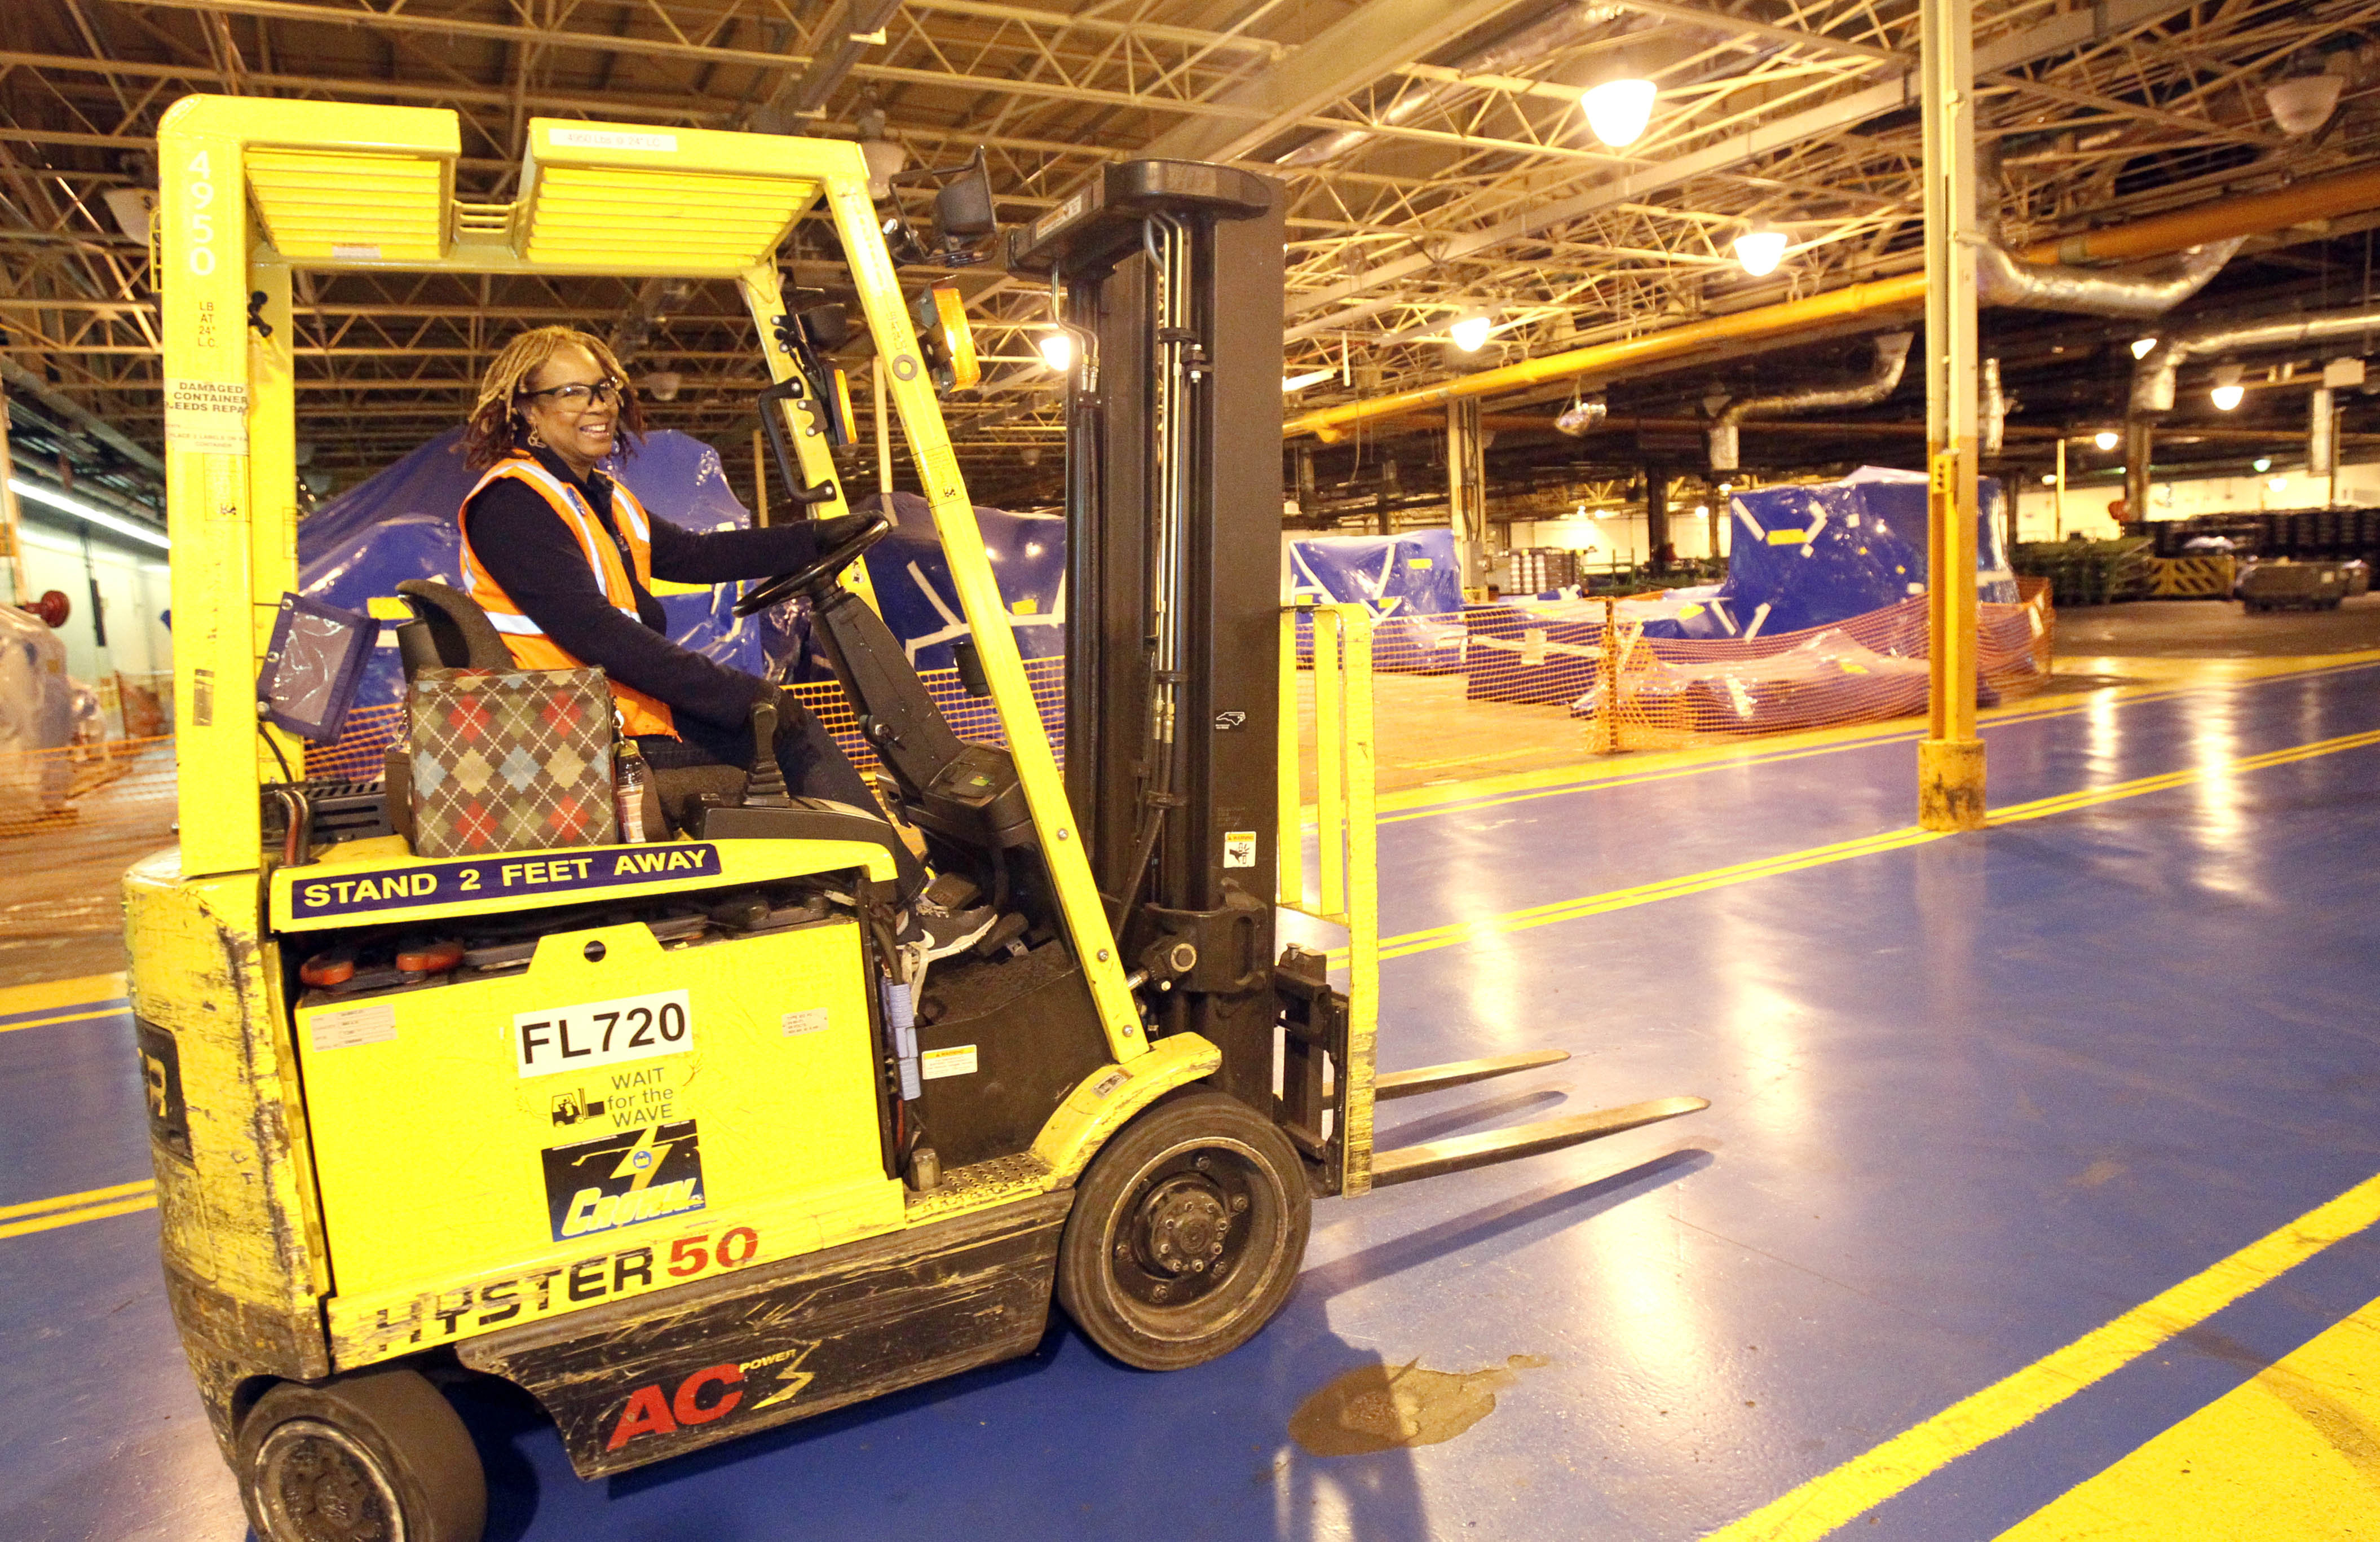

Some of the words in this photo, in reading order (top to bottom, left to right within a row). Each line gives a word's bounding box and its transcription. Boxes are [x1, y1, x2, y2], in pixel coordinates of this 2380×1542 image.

[188, 150, 217, 276] 4950
[199, 302, 214, 311] LB
[200, 314, 214, 323] AT
[174, 391, 248, 404] CONTAINER
[179, 382, 244, 394] DAMAGED
[304, 872, 437, 907] STAND
[460, 869, 481, 891] 2
[502, 857, 593, 887] FEET
[613, 849, 707, 876] AWAY
[521, 1002, 686, 1065] FL720
[611, 1067, 664, 1090] WAIT
[607, 1095, 635, 1111] for
[642, 1088, 673, 1103] the
[612, 1103, 673, 1127] WAVE
[668, 1226, 758, 1277] 50
[606, 1363, 745, 1453] AC
[739, 1348, 796, 1373] POWER
